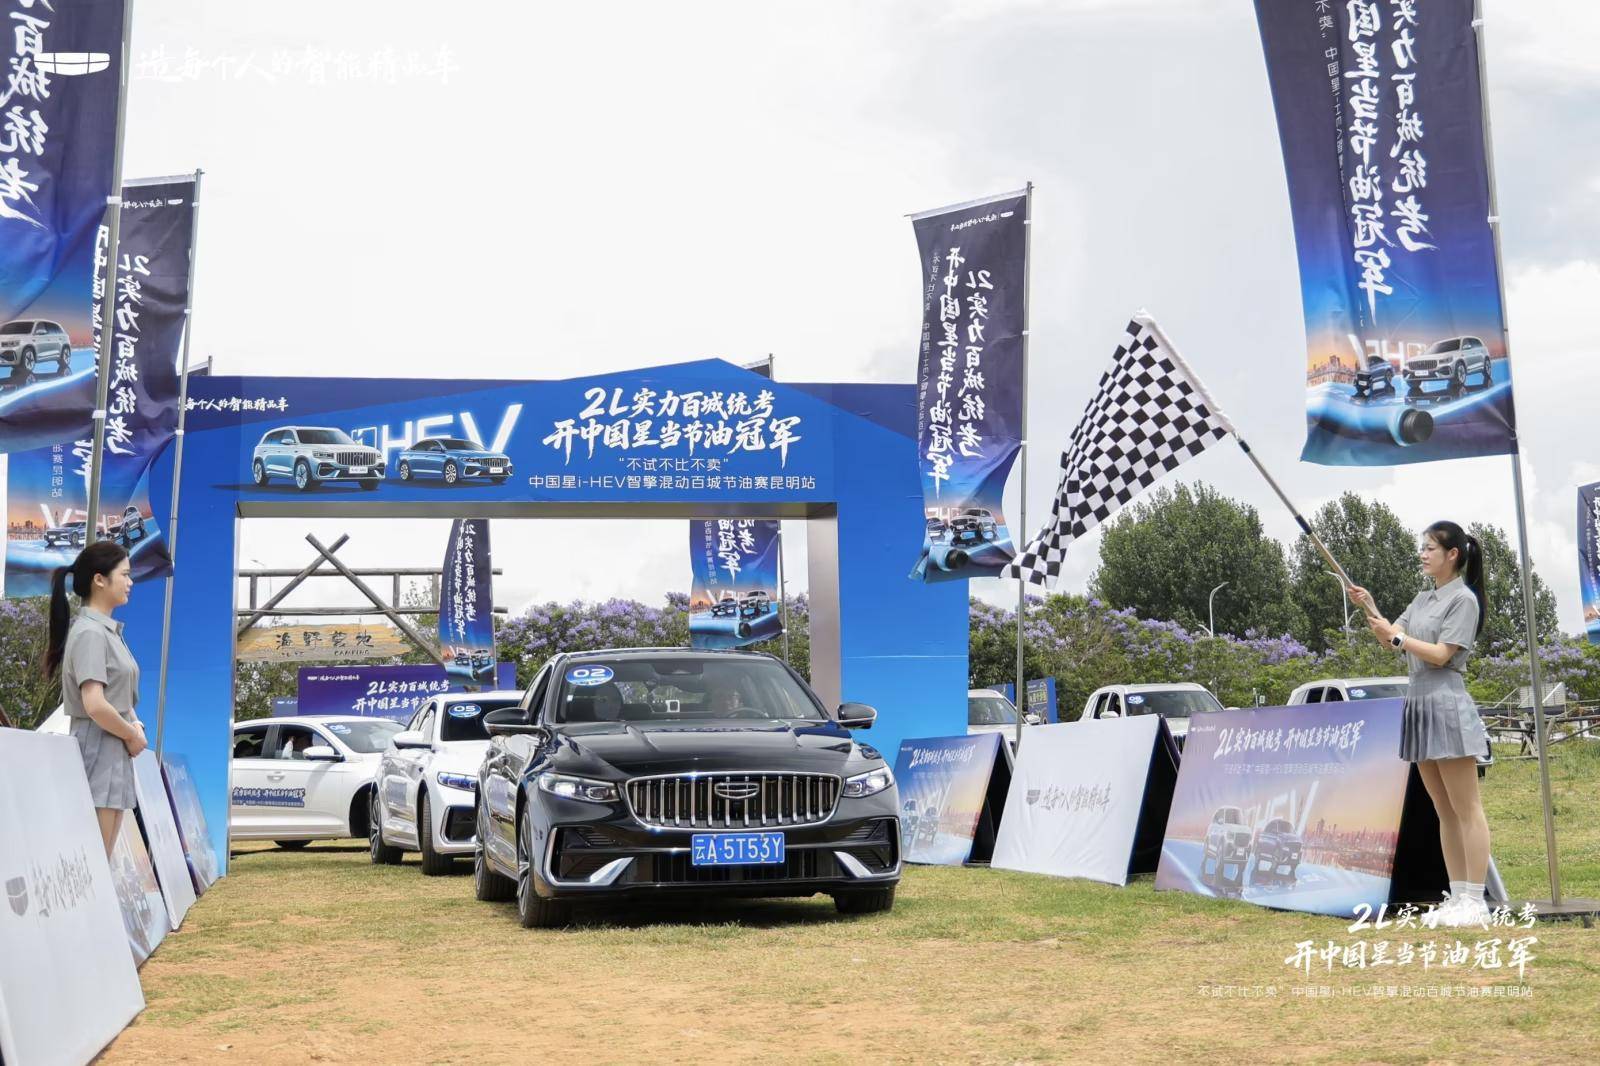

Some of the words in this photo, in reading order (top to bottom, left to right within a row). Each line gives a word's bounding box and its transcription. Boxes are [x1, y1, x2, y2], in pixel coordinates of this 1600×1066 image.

[178, 396, 289, 412] 每个人的智能精品车
[579, 387, 776, 420] 2L实力百城统考
[542, 416, 802, 469] 开中国星当节油冠军
[528, 475, 816, 490] 中国星i-HEV智擎混动百城节油赛昆明站
[573, 668, 606, 678] 02
[366, 680, 450, 695] 2L实力百城统考
[1213, 727, 1283, 760] 2L实力百城统考
[1283, 719, 1365, 760] 开中国星当节油冠军
